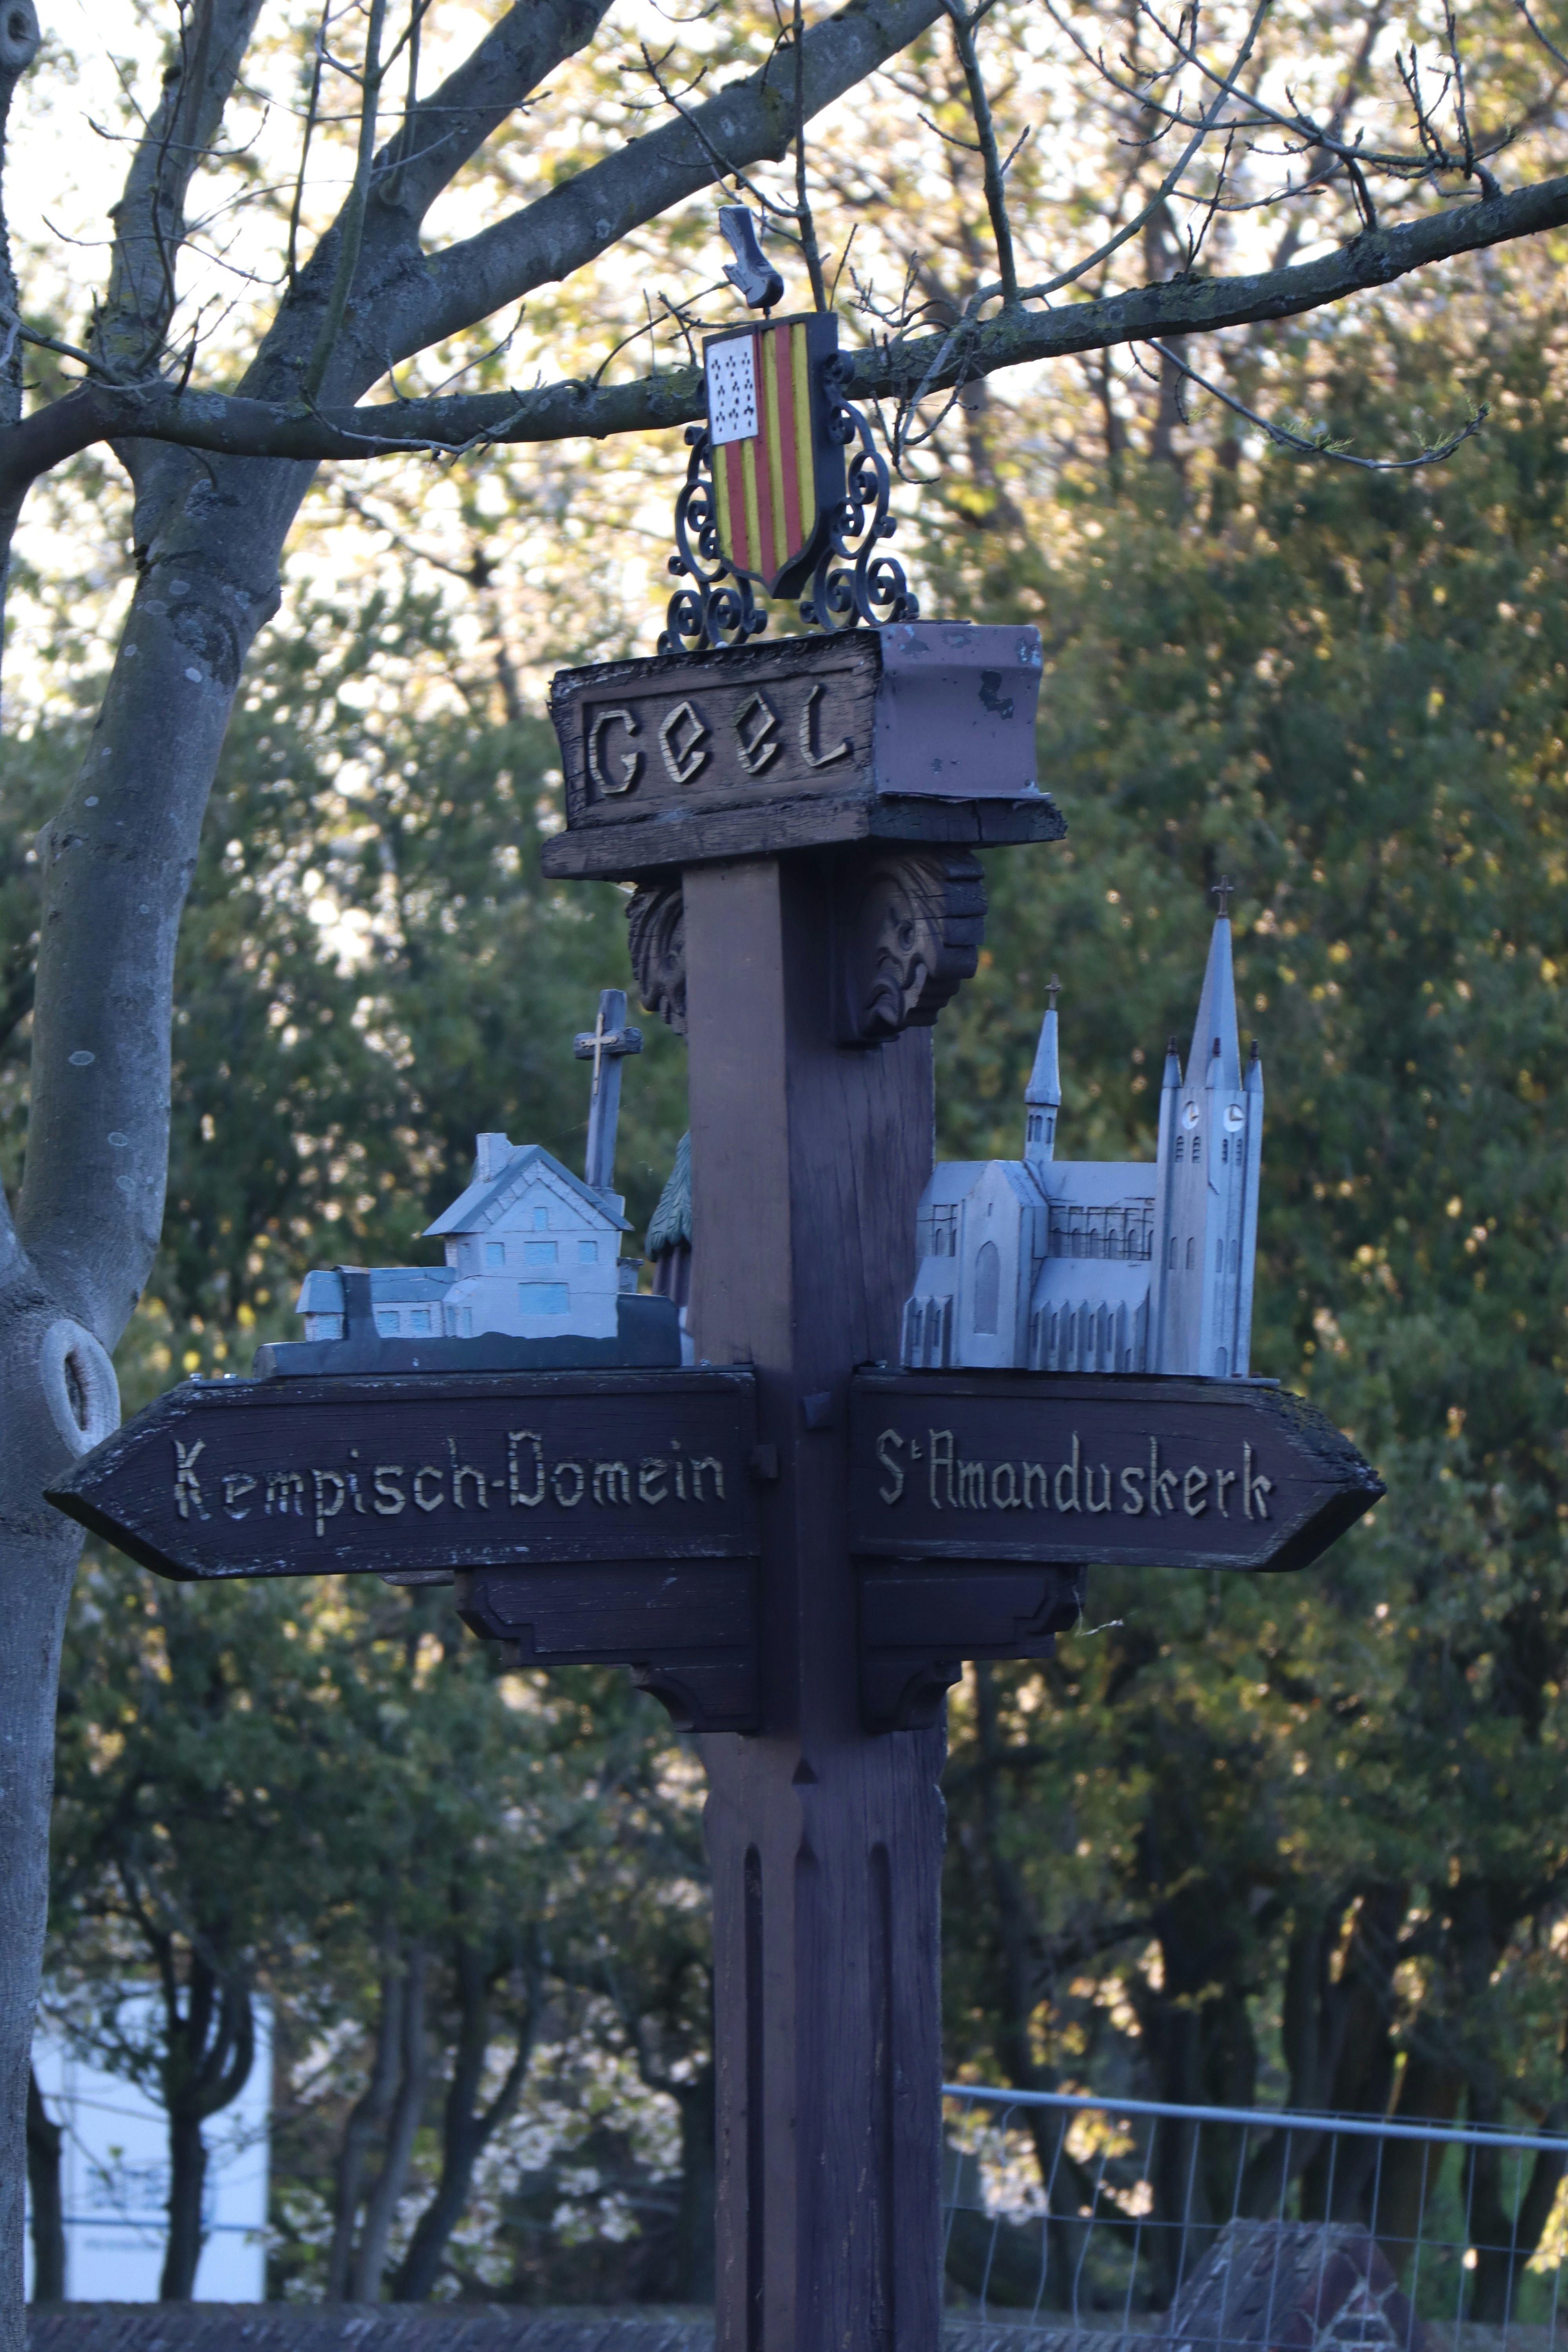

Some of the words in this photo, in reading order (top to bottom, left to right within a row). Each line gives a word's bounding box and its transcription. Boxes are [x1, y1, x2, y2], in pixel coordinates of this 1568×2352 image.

[173, 1430, 726, 1537] Kempisch-Domein
[877, 1428, 922, 1504] St
[929, 1429, 1272, 1519] Amanduskerk
